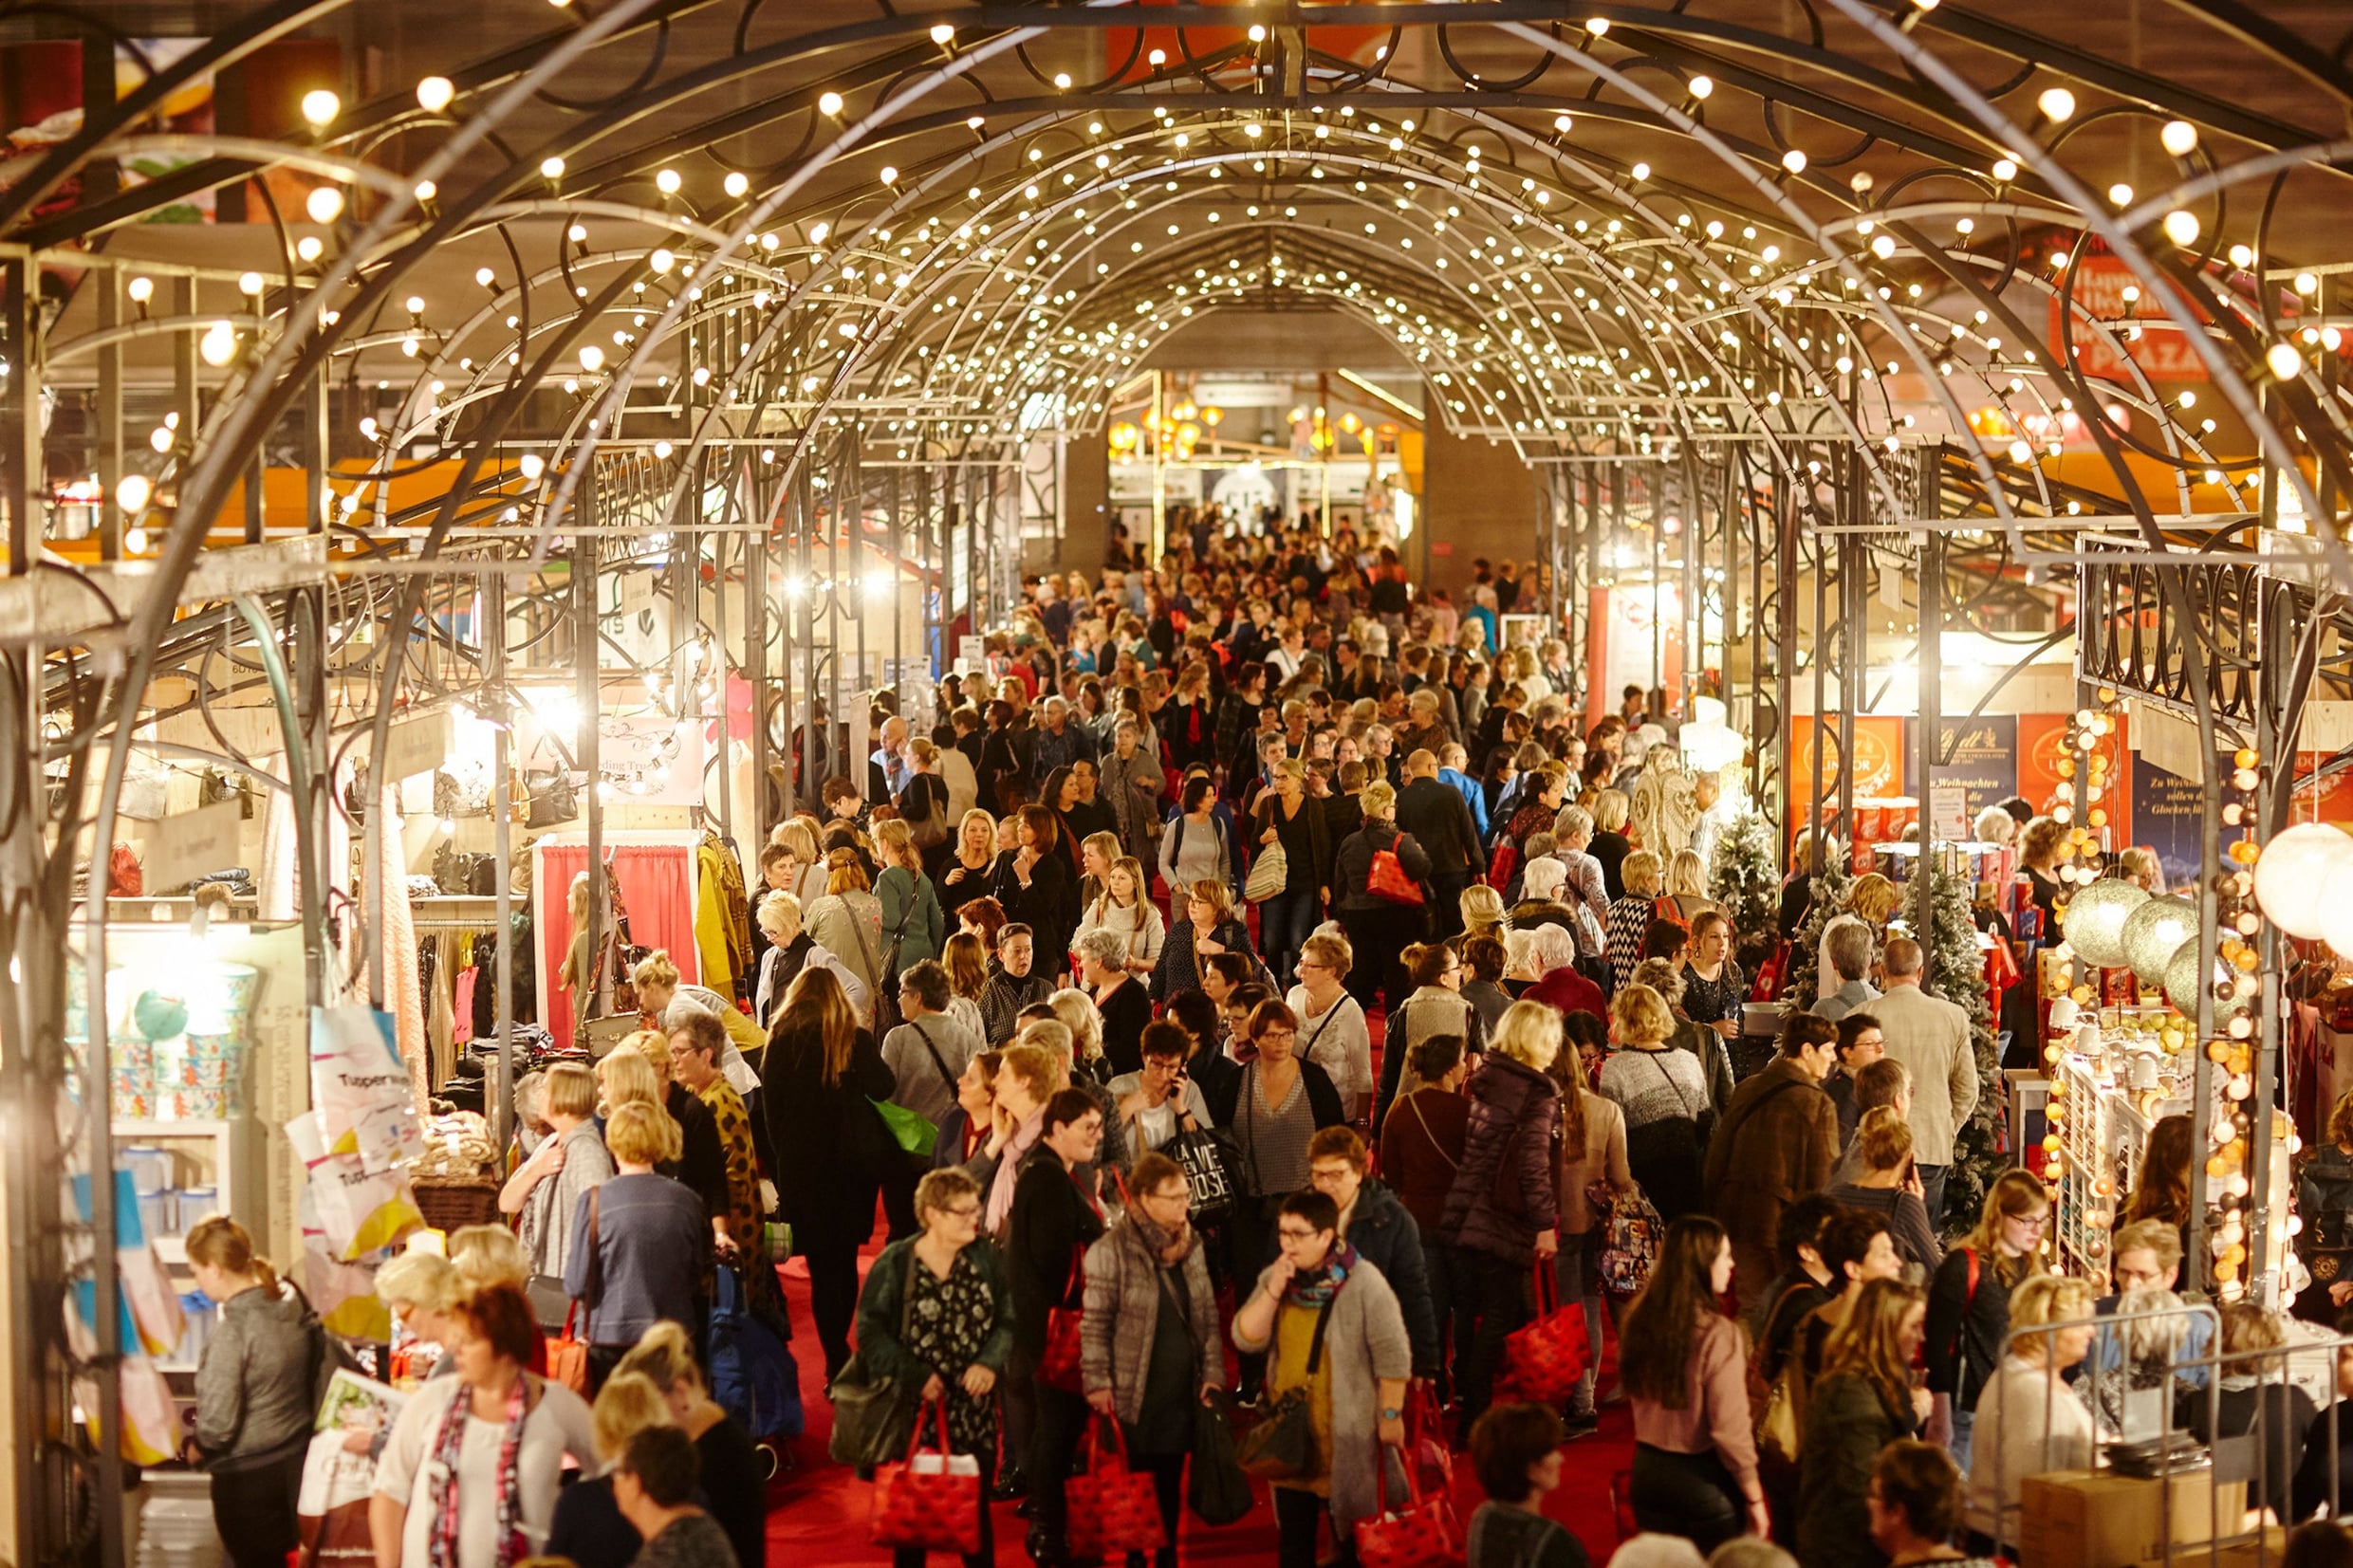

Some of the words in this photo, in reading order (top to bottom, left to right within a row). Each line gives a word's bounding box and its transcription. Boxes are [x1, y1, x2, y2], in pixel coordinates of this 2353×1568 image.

[1938, 777, 1999, 789] Weihnachten
[2151, 803, 2190, 815] Glocken
[1174, 1144, 1190, 1161] LA
[1194, 1144, 1223, 1171] VIE
